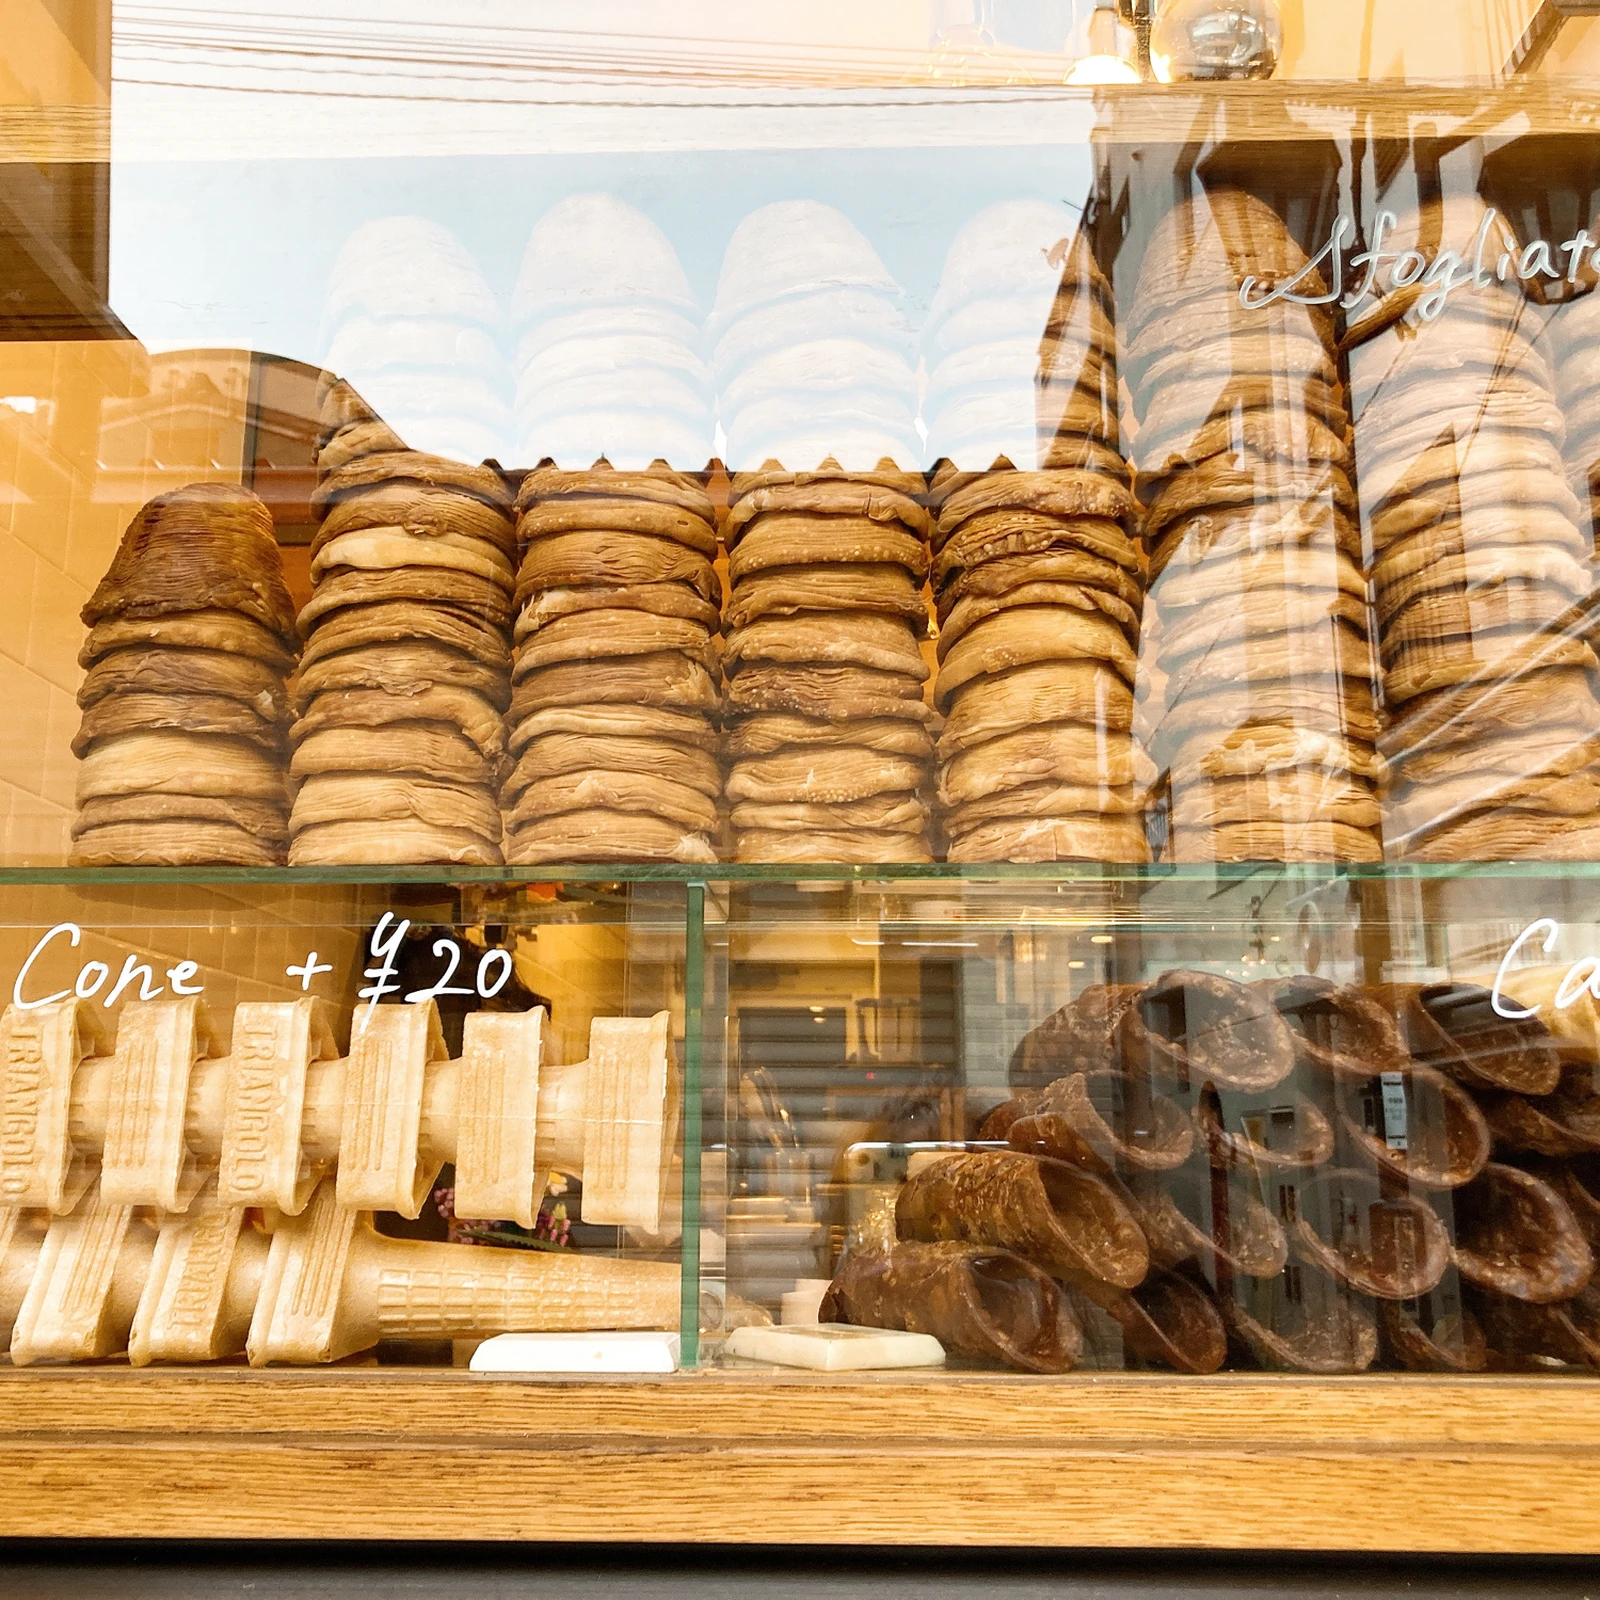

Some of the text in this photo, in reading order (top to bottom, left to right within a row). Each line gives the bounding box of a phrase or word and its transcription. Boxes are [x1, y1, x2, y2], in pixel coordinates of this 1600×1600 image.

[13, 922, 205, 1010] Cone
[285, 951, 333, 991] +
[227, 1014, 279, 1193] TRIANGOLO
